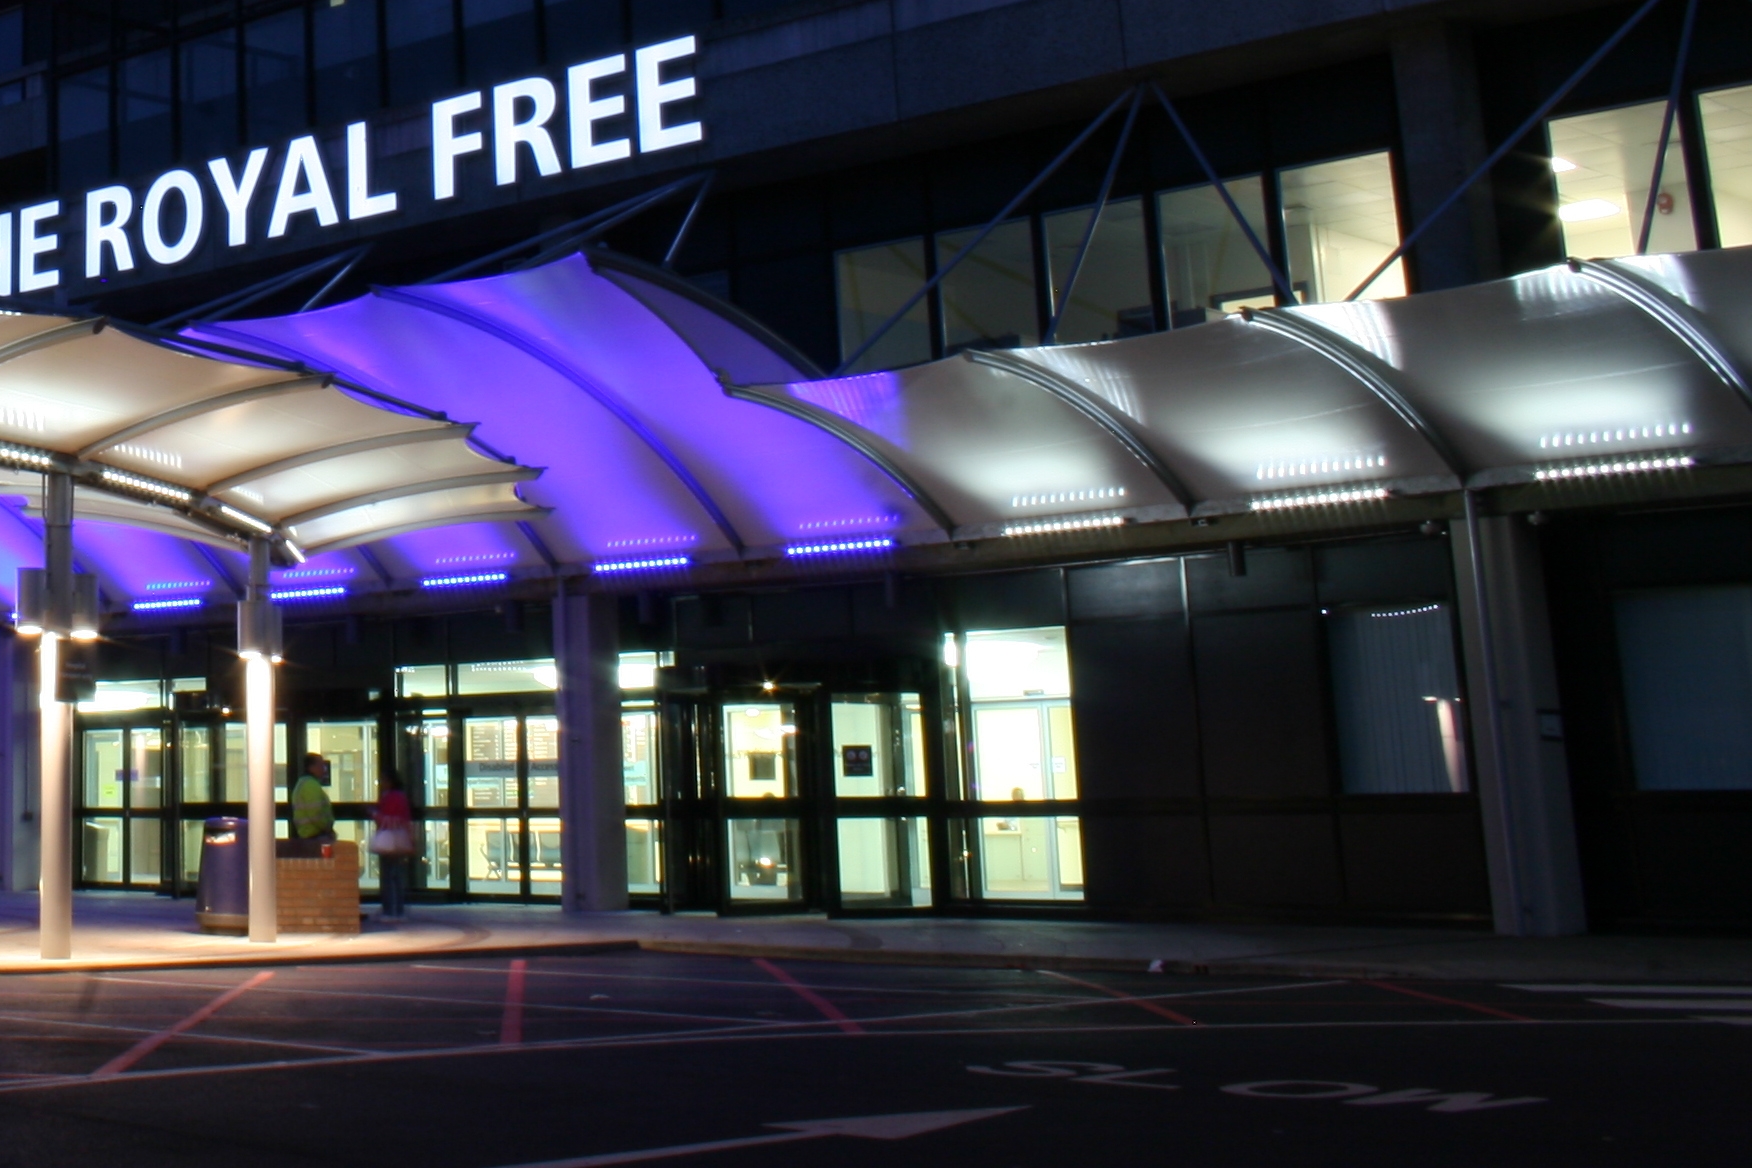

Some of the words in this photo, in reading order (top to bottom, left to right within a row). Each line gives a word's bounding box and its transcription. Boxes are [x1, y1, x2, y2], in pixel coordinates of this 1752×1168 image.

[84, 120, 398, 279] ROYAL
[431, 34, 704, 201] FREE
[965, 1059, 1550, 1113] SLOW
